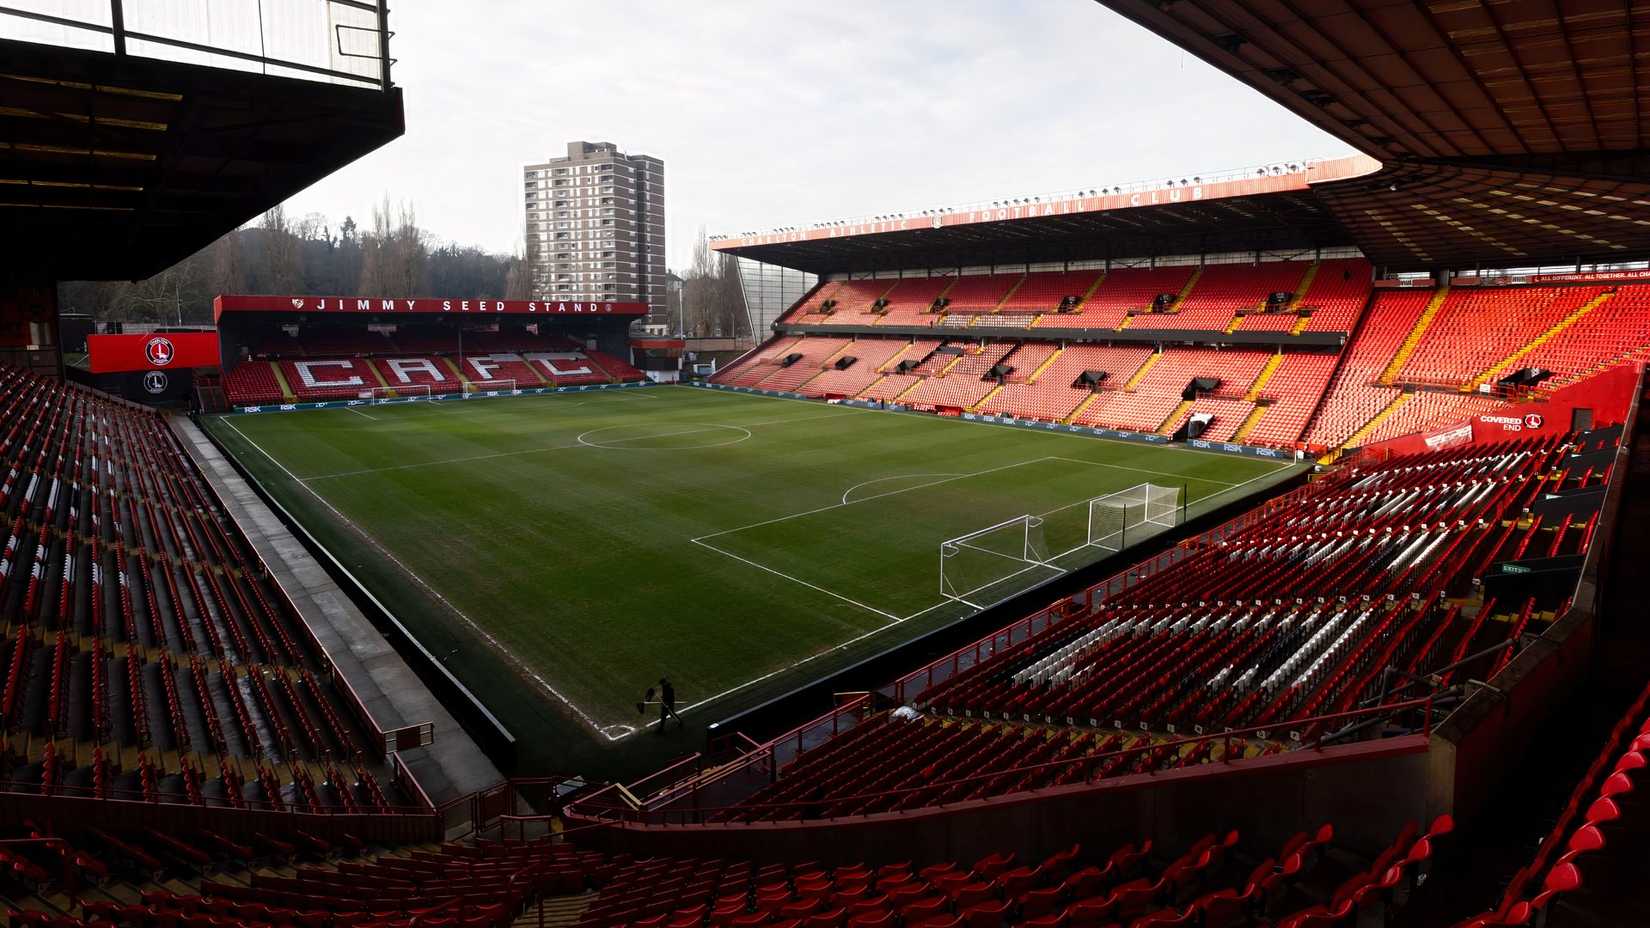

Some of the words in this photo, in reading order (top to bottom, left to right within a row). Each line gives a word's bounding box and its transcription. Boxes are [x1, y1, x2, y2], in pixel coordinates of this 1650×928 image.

[969, 199, 1085, 222] FOOTBALL
[1131, 187, 1202, 206] CLUB
[316, 299, 416, 310] JIMMY
[443, 300, 505, 311] SEED
[529, 302, 598, 312] STAND
[244, 406, 261, 414] RSK
[1480, 415, 1522, 424] COVERED
[1503, 424, 1522, 432] END
[1193, 439, 1211, 449] RSK
[1223, 443, 1243, 453] RSK
[1256, 447, 1276, 457] RSK
